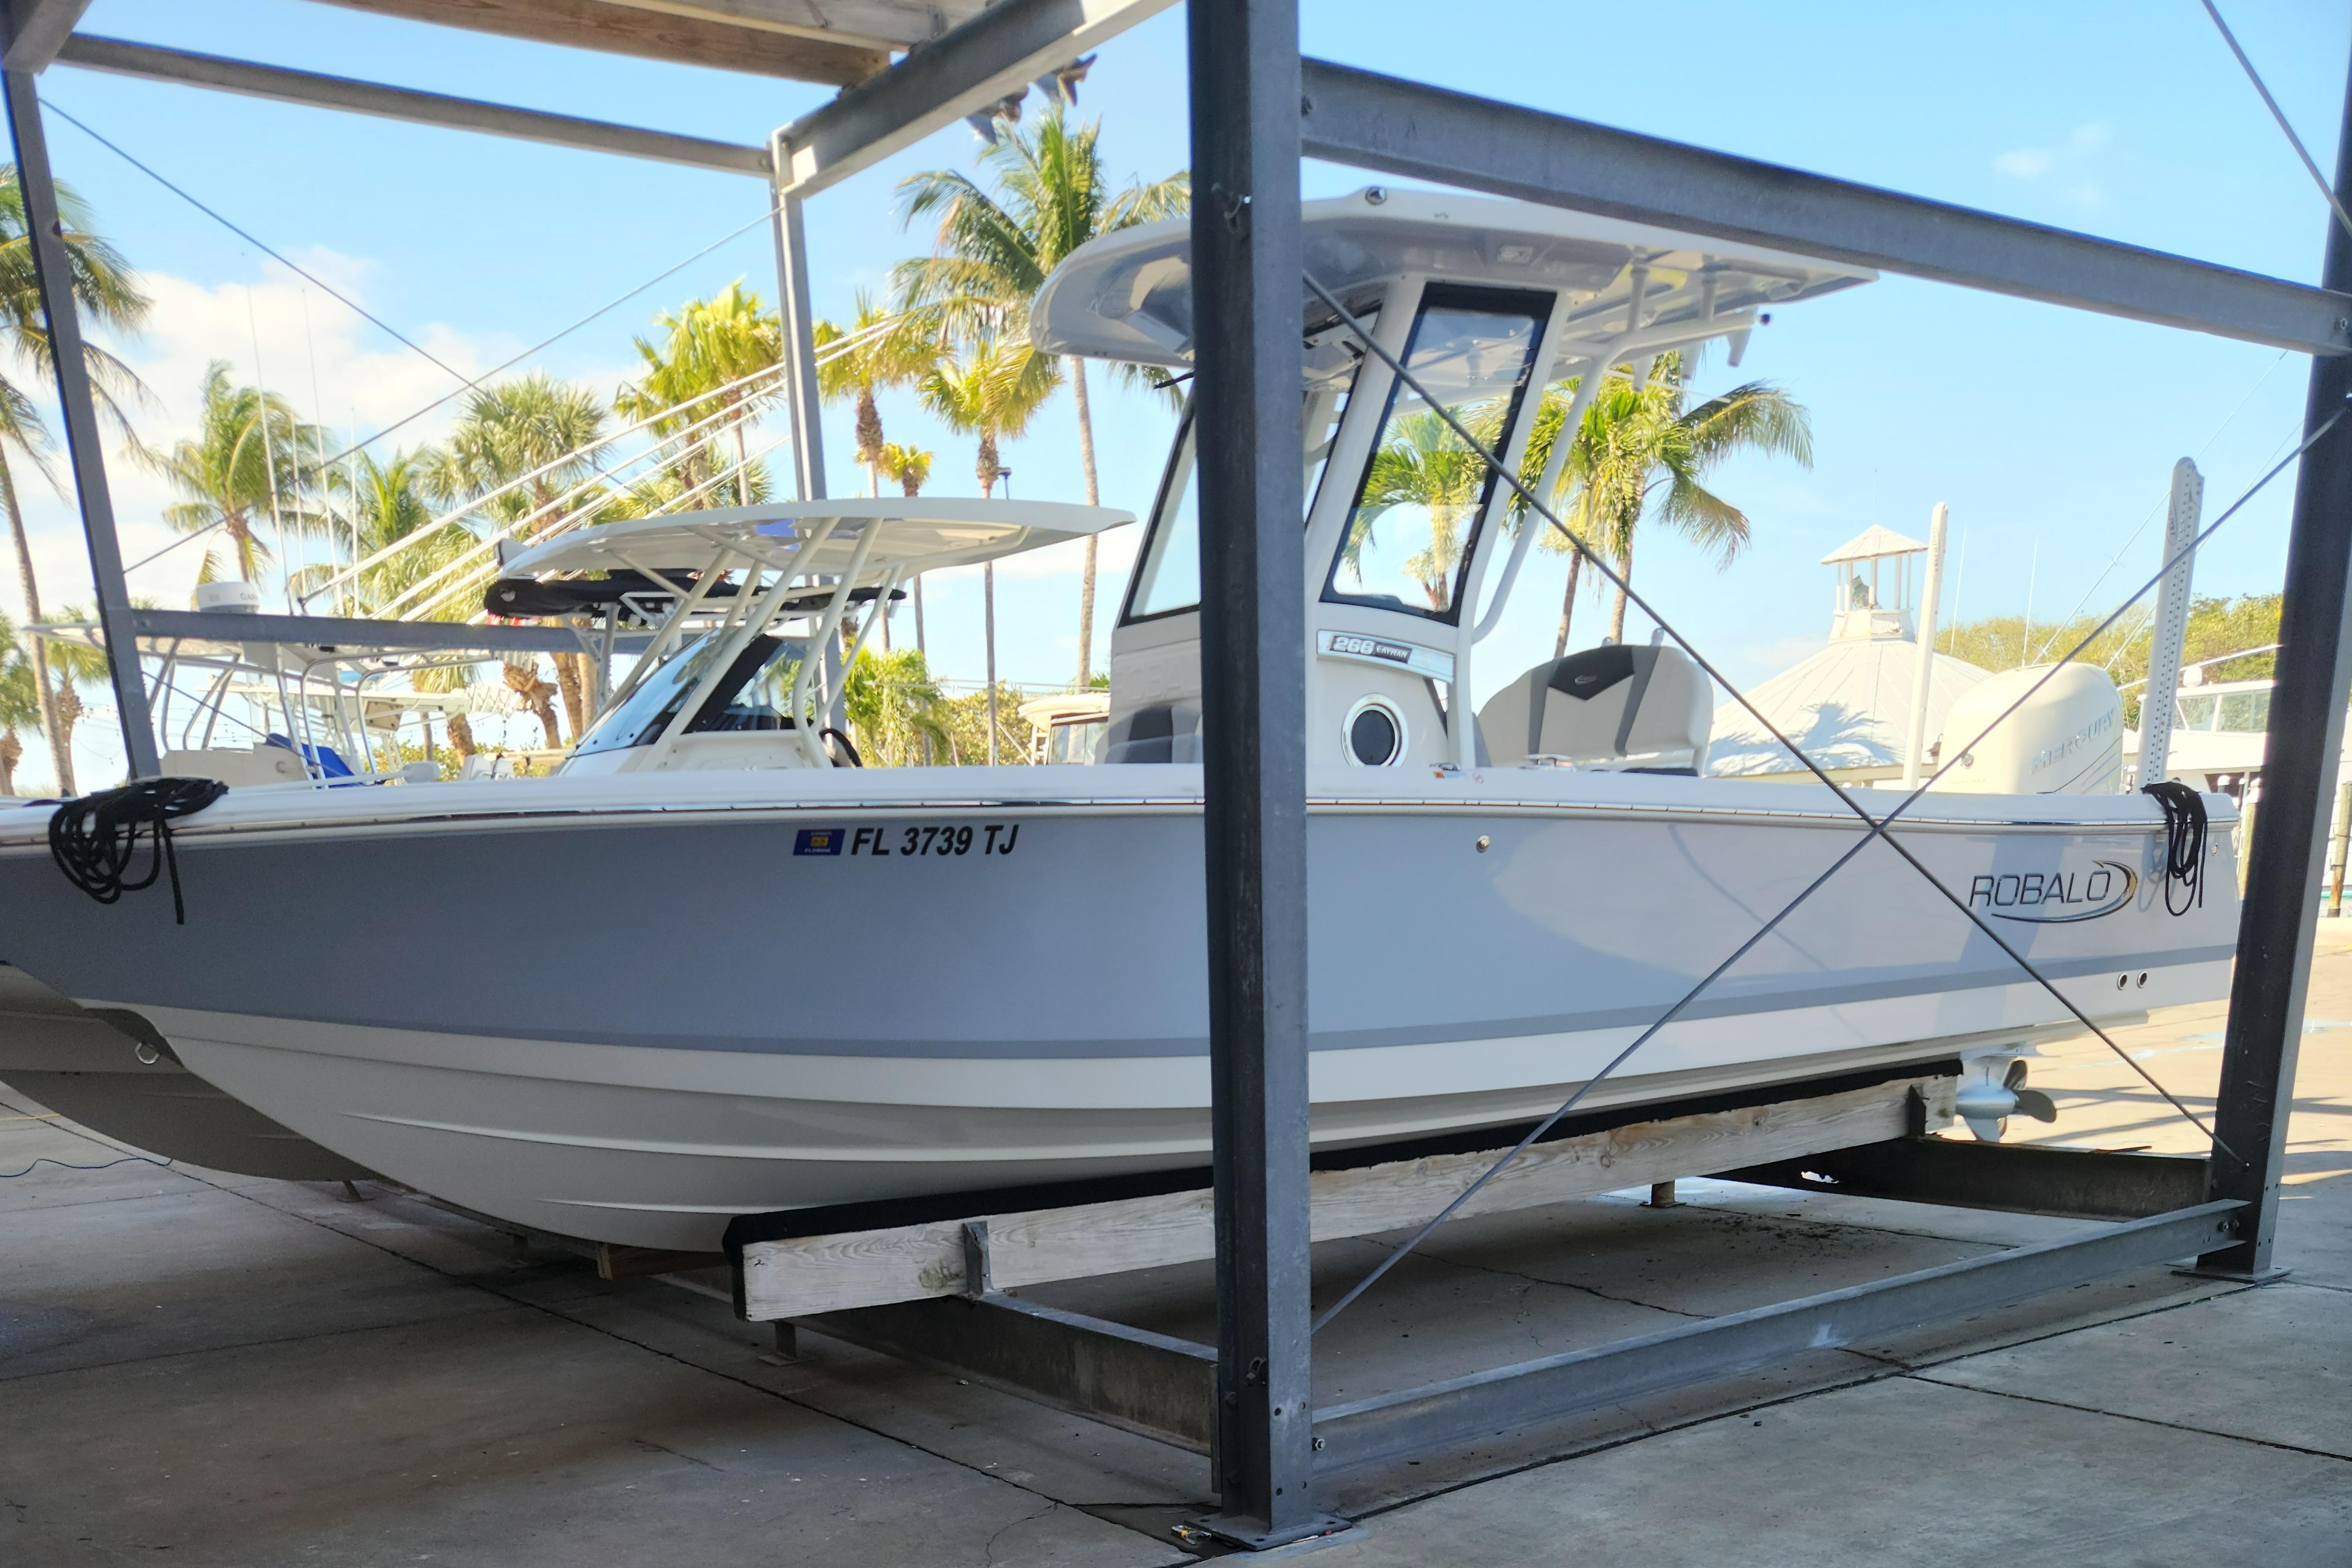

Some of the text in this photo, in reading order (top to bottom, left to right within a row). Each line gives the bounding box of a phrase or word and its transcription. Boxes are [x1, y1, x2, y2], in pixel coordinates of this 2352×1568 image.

[1333, 636, 1409, 658] 266 CAYMAN
[2030, 706, 2116, 775] MERCURY
[851, 824, 1020, 855] FL 3739 TJ
[1969, 870, 2111, 907] ROBALO
